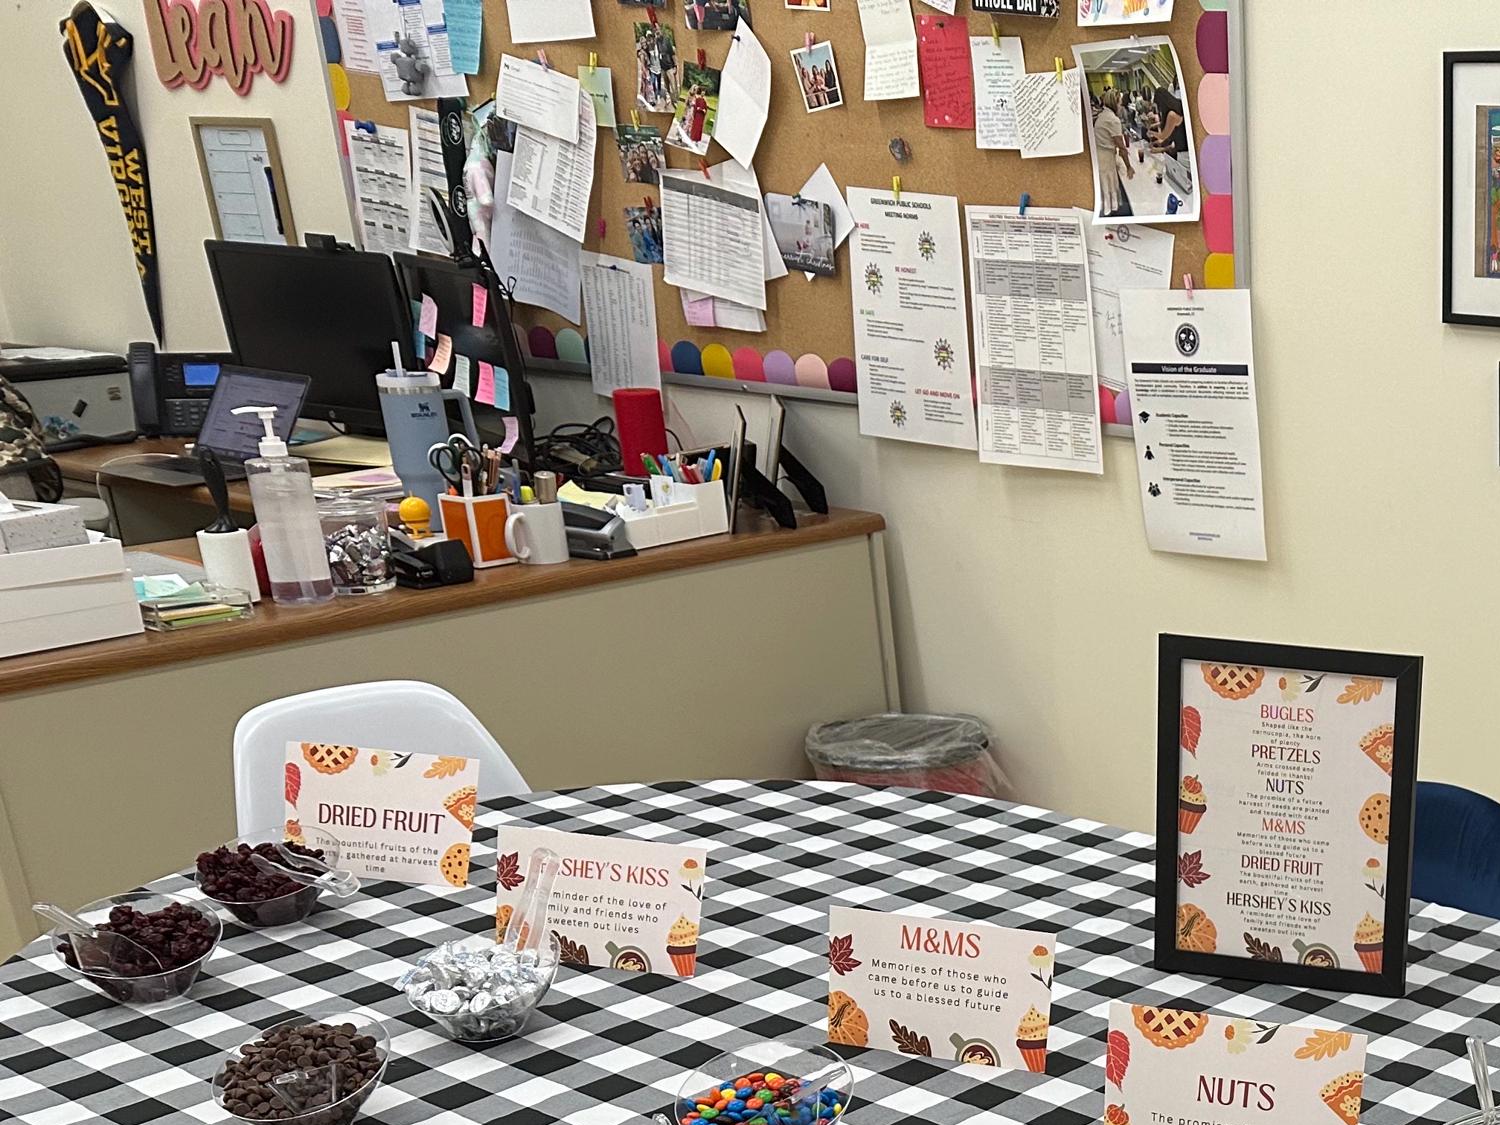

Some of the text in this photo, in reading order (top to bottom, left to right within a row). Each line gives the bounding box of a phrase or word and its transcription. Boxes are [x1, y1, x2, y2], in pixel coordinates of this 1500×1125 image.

[124, 148, 151, 254] WEST
[896, 199, 911, 208] PUBLIC
[912, 201, 931, 210] SCHOOLS
[1260, 704, 1314, 723] BUGLES
[1251, 744, 1321, 765] PRETZELS
[1266, 778, 1304, 795] NUTS
[318, 803, 446, 835] DRIED FRUIT
[1261, 817, 1306, 835] M&MS
[627, 865, 669, 887] KISS
[1241, 854, 1324, 876] DRIED FRUIT
[1226, 892, 1332, 916] HERSHEY'S KISS
[900, 925, 981, 959] M&MS
[871, 958, 1007, 985] Memories of those who
[868, 973, 1009, 1000] came before us to guide
[874, 988, 1001, 1013] us to a blessed future
[1197, 1075, 1276, 1111] NUTS
[1151, 1112, 1174, 1124] The
